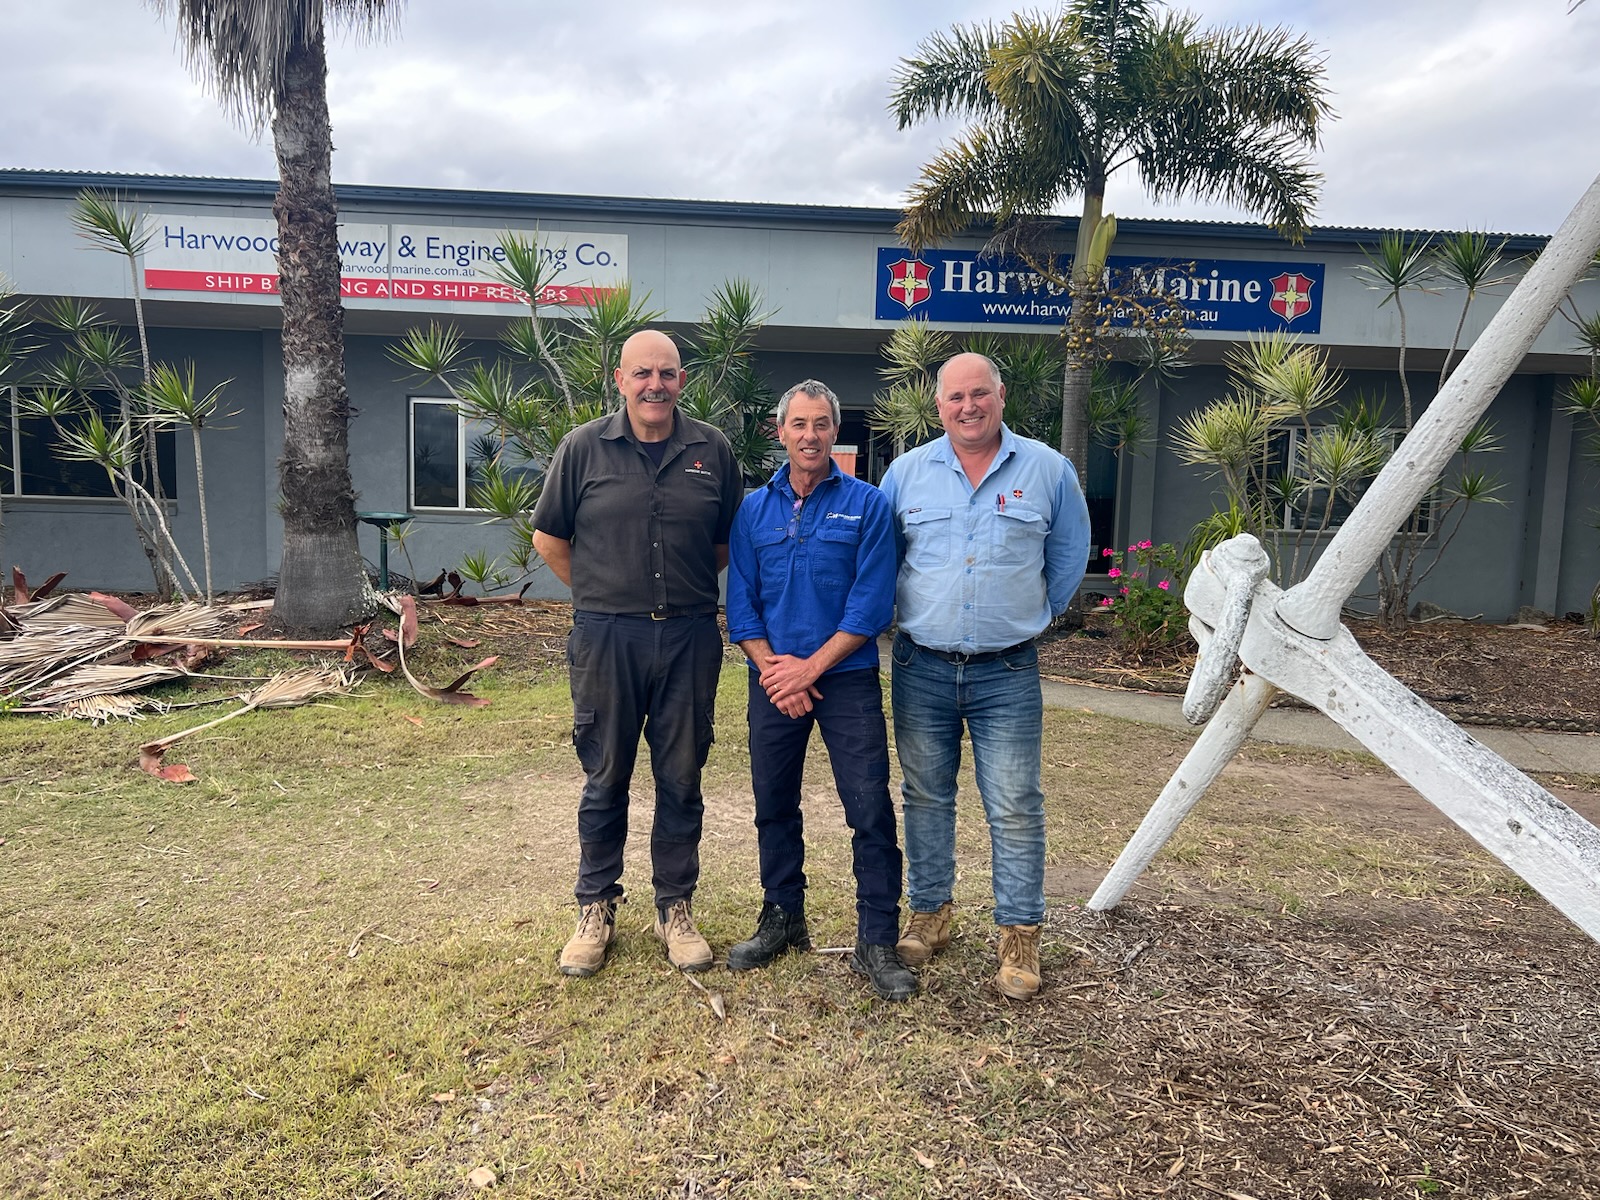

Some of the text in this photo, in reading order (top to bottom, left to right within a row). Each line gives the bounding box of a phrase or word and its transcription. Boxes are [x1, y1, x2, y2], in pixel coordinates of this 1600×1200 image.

[398, 235, 416, 258] &
[575, 242, 618, 267] Co.
[205, 275, 254, 289] SHIP
[375, 282, 426, 296] AND
[432, 283, 479, 298] SHIP
[486, 286, 568, 302] REPRS
[940, 259, 1262, 304] Harwo Marine
